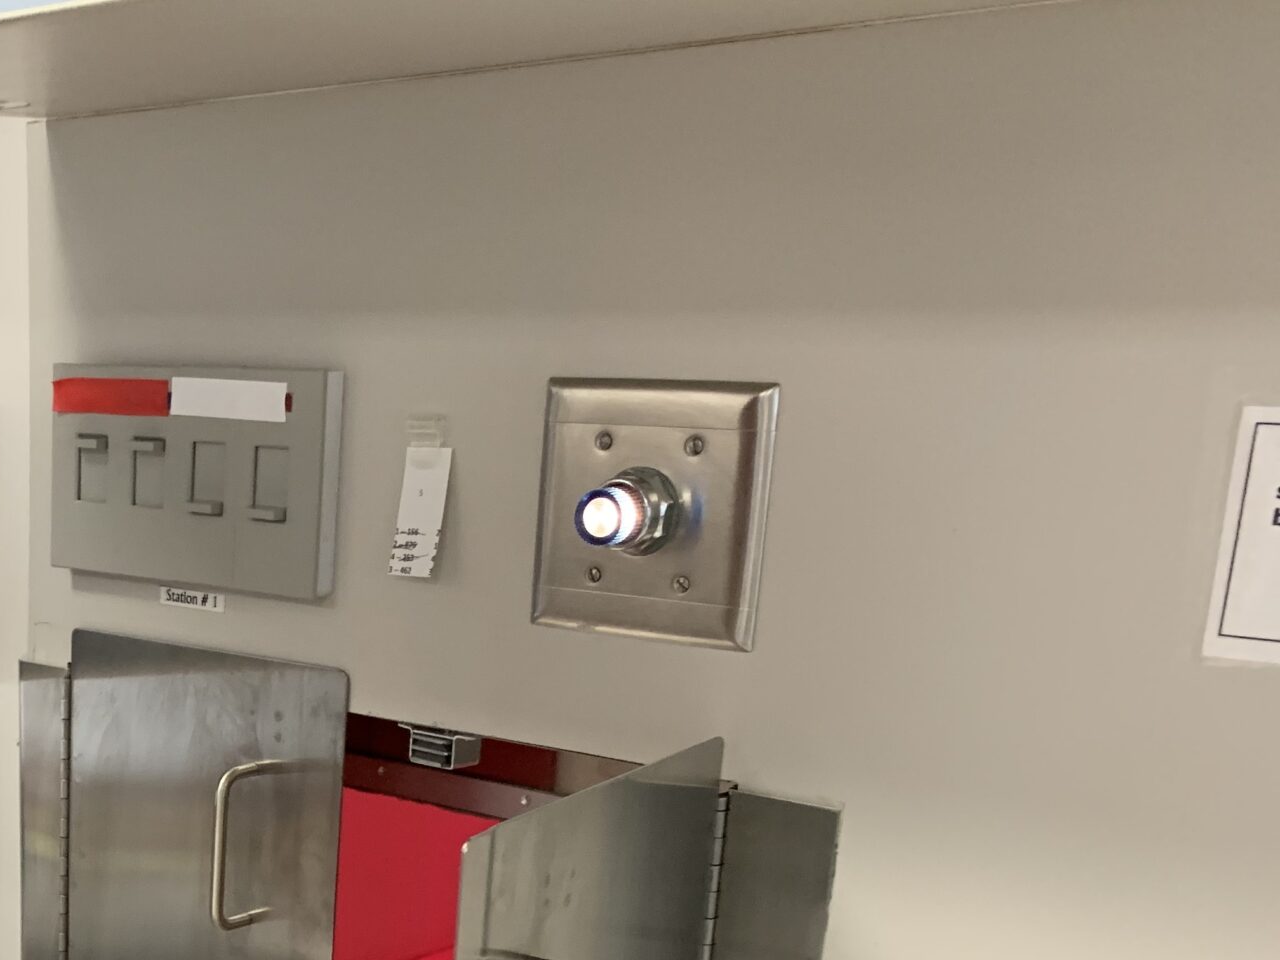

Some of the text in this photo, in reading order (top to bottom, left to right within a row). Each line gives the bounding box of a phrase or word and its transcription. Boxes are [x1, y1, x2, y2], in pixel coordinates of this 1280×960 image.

[166, 588, 217, 608] Station # 1
